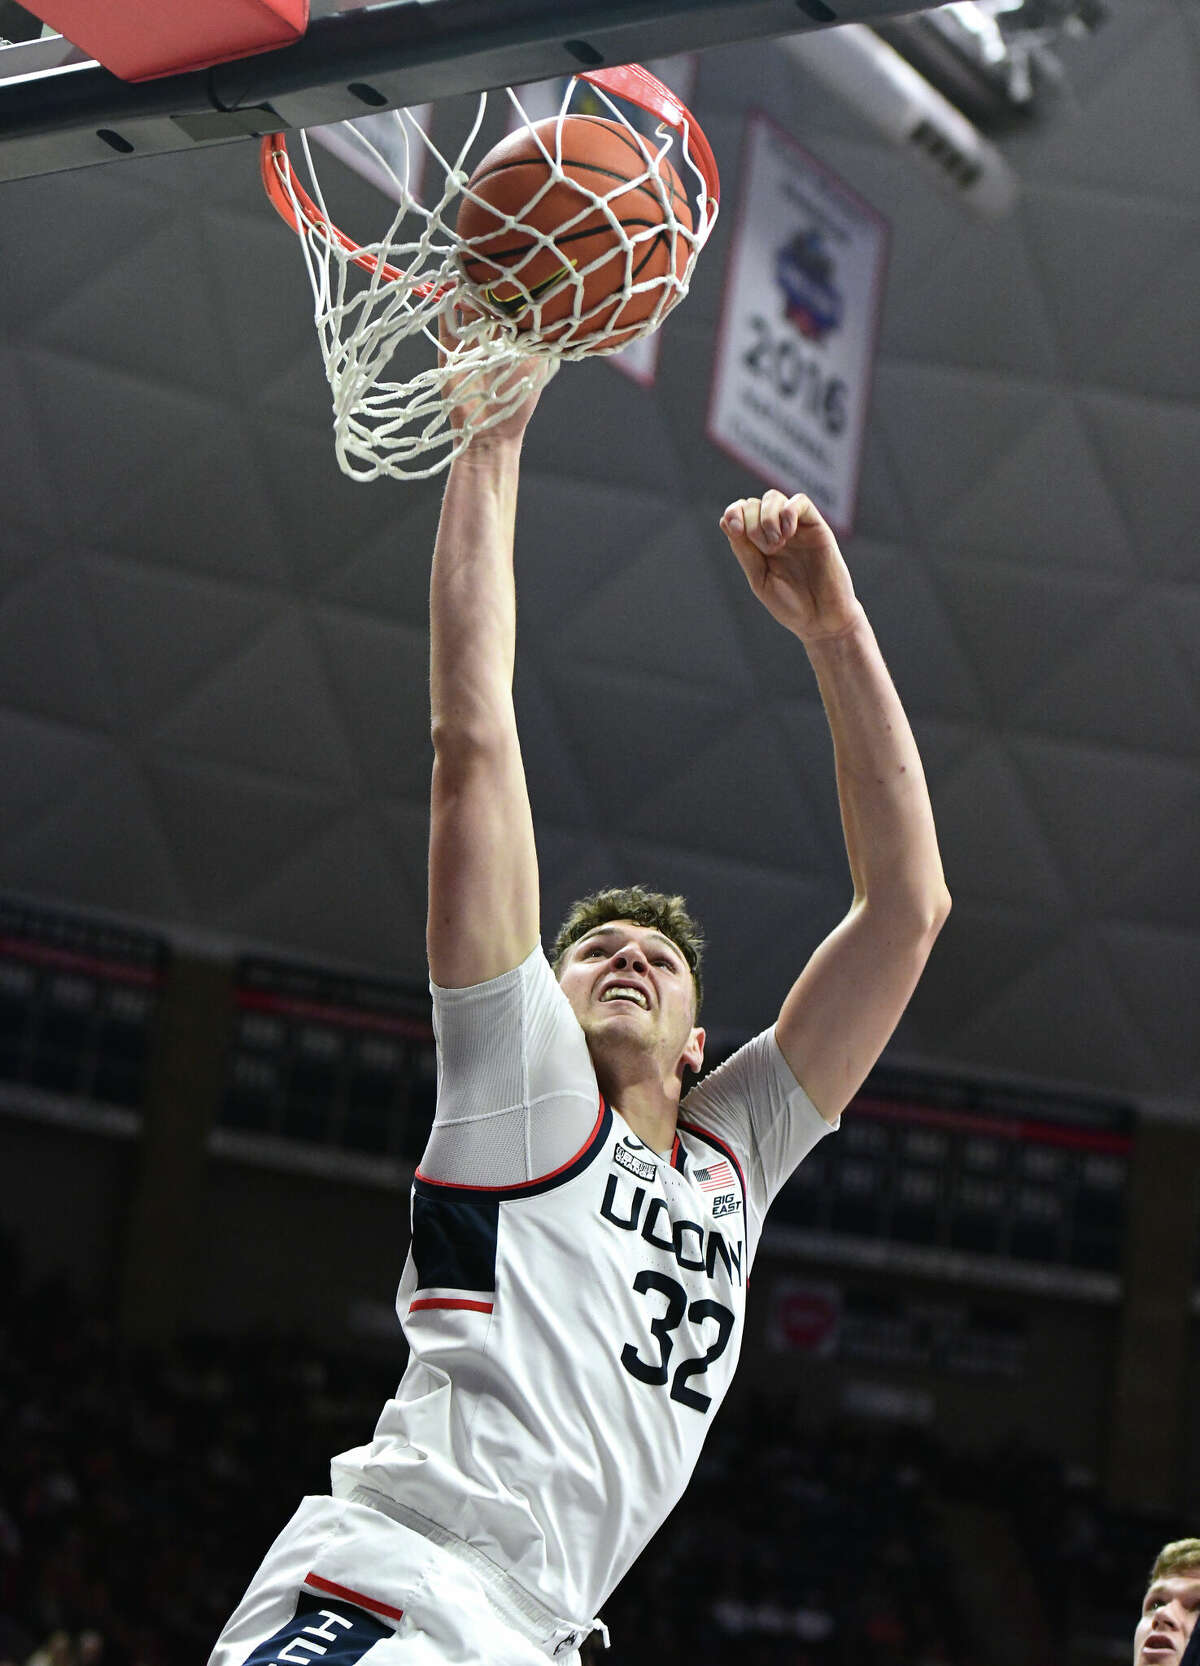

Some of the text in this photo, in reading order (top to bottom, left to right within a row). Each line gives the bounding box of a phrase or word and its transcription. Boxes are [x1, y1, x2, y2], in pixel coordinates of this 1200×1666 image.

[743, 315, 848, 438] 2016
[600, 1173, 742, 1287] UCONN
[712, 1201, 742, 1215] EAST
[713, 1193, 735, 1206] BIG
[621, 1270, 735, 1414] 32
[270, 1610, 354, 1666] HU
